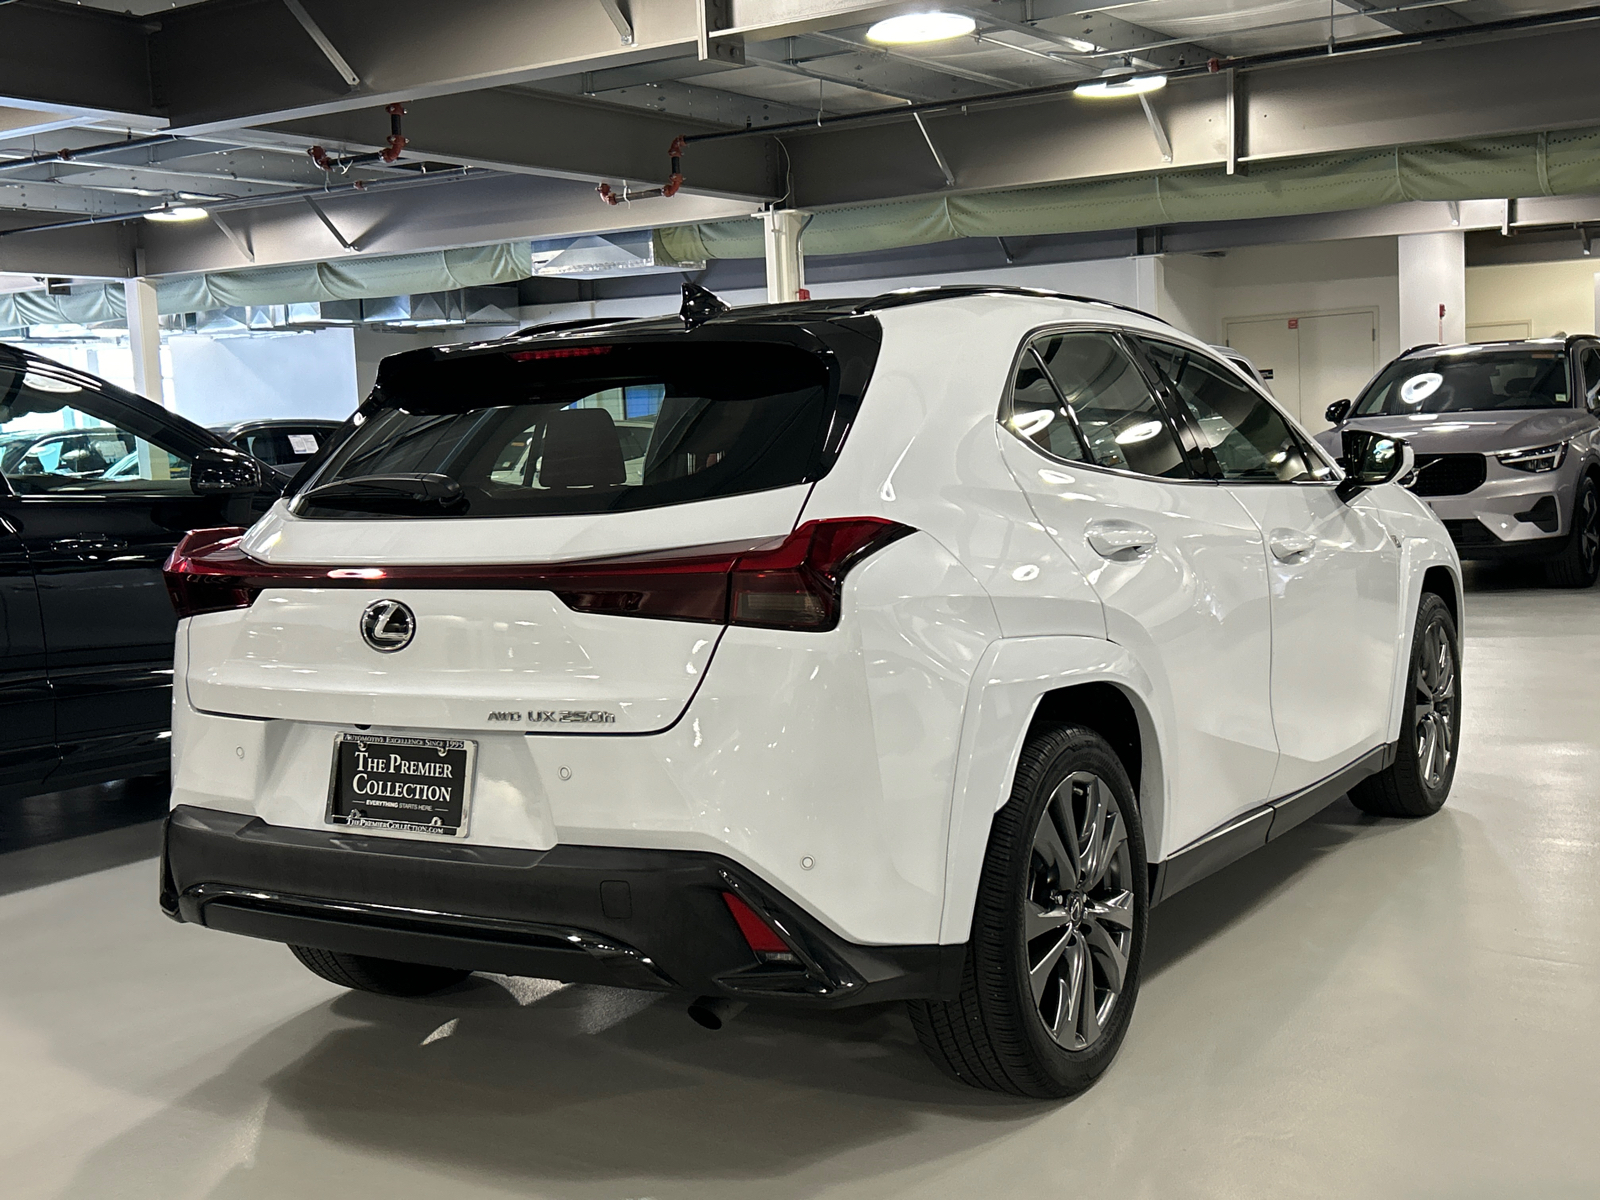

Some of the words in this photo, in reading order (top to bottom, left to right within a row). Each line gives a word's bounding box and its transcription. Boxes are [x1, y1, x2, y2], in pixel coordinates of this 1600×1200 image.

[487, 711, 521, 722] AWD
[527, 711, 557, 722] UX
[559, 711, 615, 722] 250h
[425, 739, 443, 747] SINCE
[366, 800, 398, 808] EVERYTHING
[399, 802, 418, 810] STARTS
